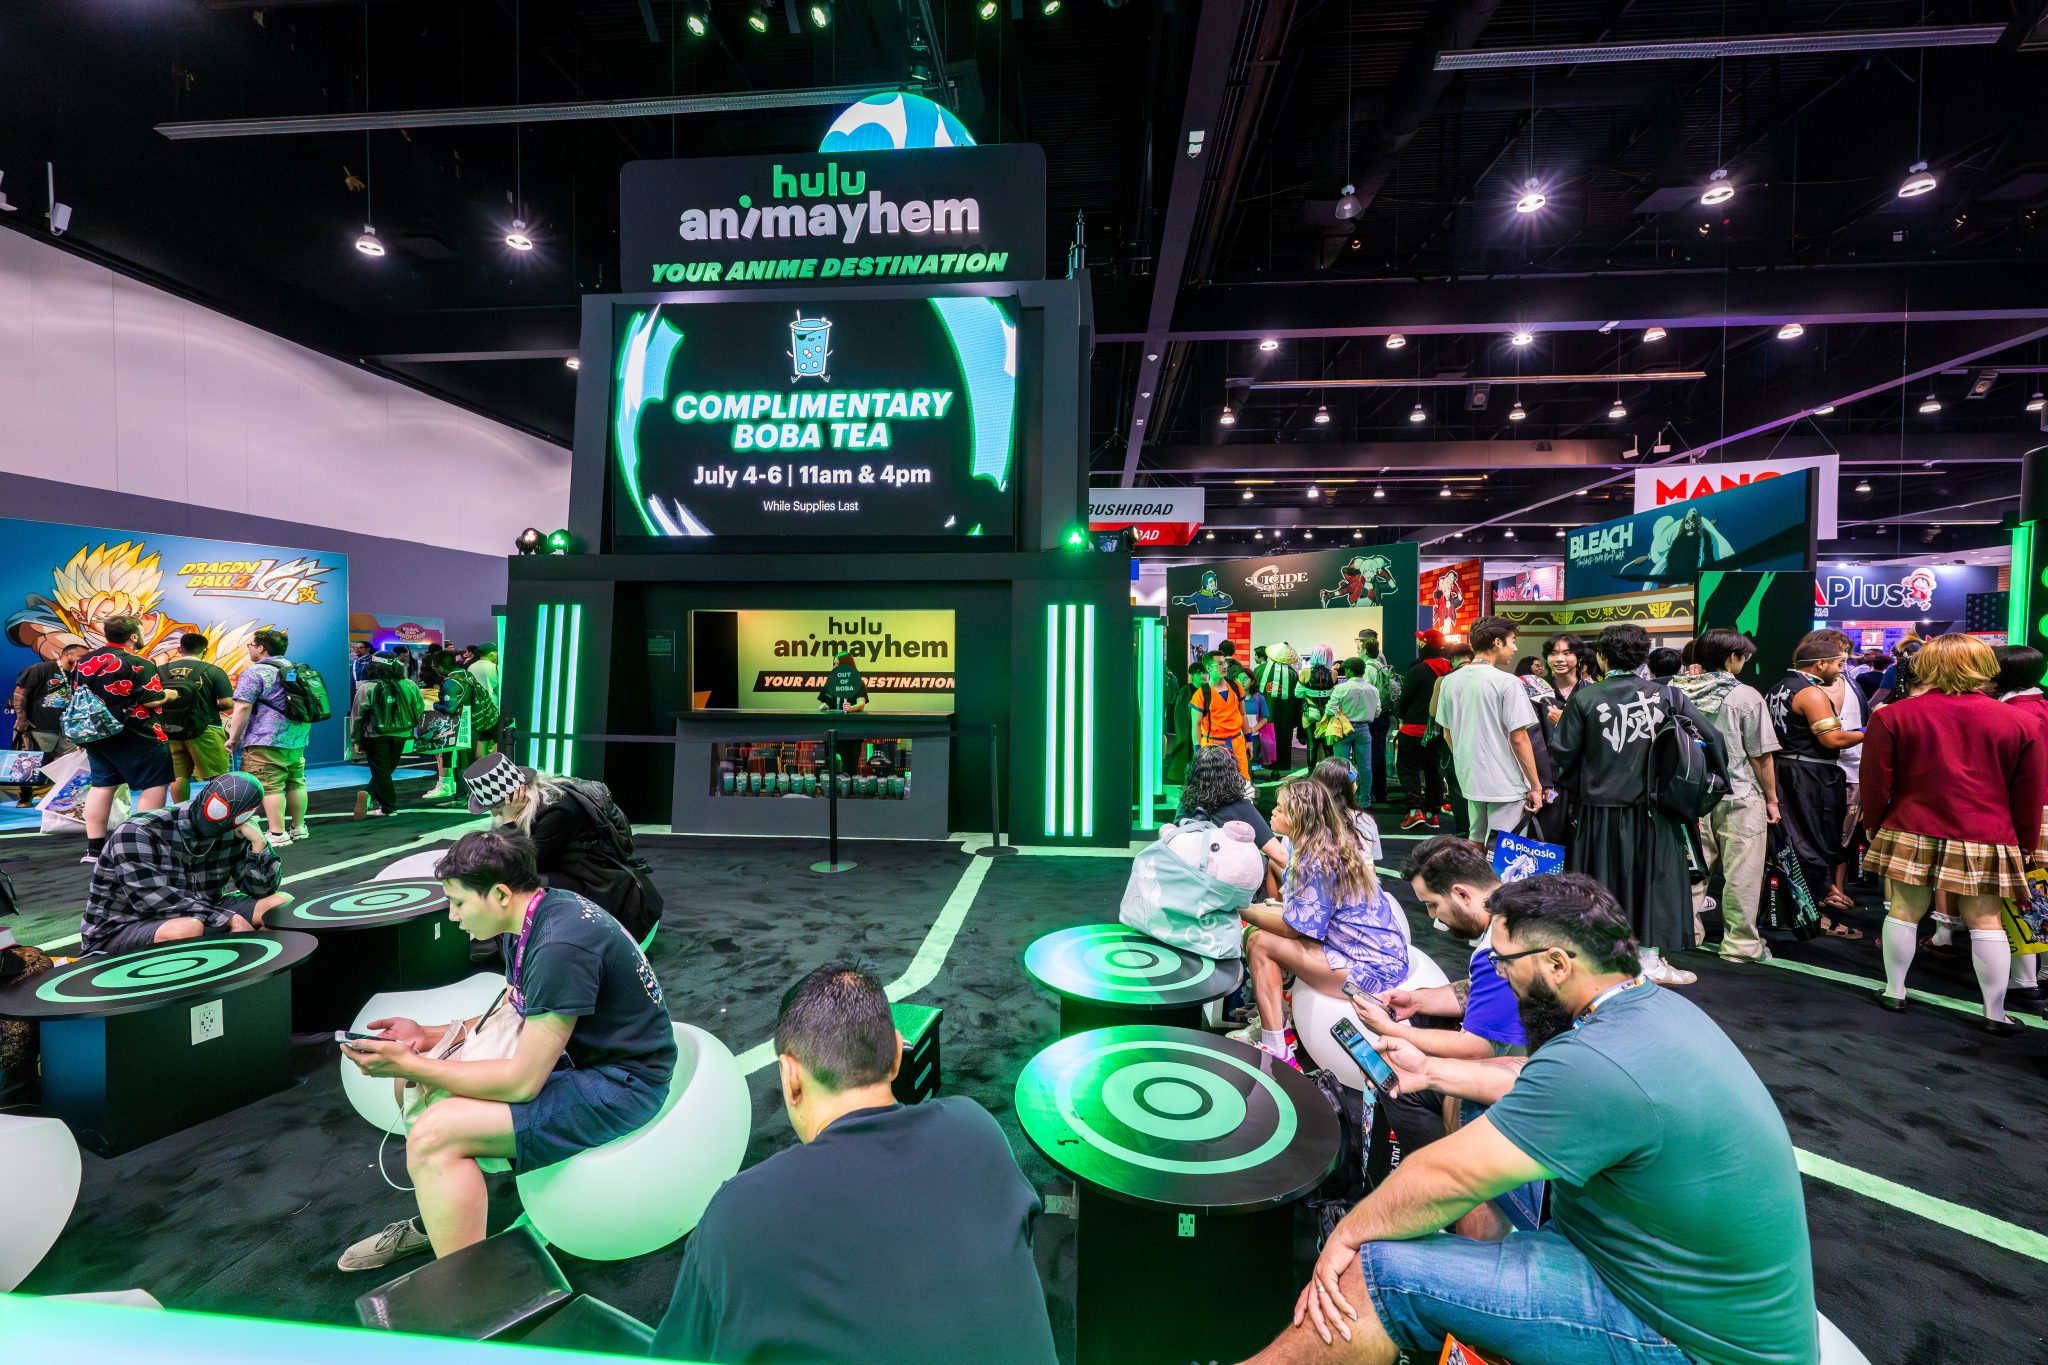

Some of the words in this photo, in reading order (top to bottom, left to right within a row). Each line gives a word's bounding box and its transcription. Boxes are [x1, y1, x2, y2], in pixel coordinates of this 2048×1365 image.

[773, 162, 866, 198] hulu
[679, 190, 980, 244] animayhem
[652, 262, 726, 285] YOUR
[726, 258, 818, 282] ANIME
[820, 251, 1009, 278] DESTINATION
[675, 391, 953, 420] COMPLIMENTARY
[733, 423, 821, 450] BOBA
[830, 422, 890, 448] TEA
[693, 466, 738, 488] July
[742, 465, 782, 485] 4-6
[799, 465, 853, 484] 11am
[858, 465, 875, 484] &
[880, 465, 931, 488] 4pm
[763, 500, 791, 512] While
[793, 500, 835, 514] Supplies
[838, 500, 859, 511] Last
[1089, 503, 1174, 516] BUSHIROAD
[1569, 522, 1633, 559] BLEACH
[177, 561, 261, 576] DRAGON
[186, 574, 232, 588] BALL
[1244, 572, 1308, 587] SUICIDE
[1257, 582, 1295, 592] SQUAD
[297, 587, 321, 604] 改
[828, 616, 882, 635] hulu
[774, 633, 948, 663] animayhem
[764, 676, 803, 688] YOUR
[861, 676, 955, 689] DESTINATION
[1515, 843, 1556, 860] playasia
[1390, 1145, 1401, 1168] JULY
